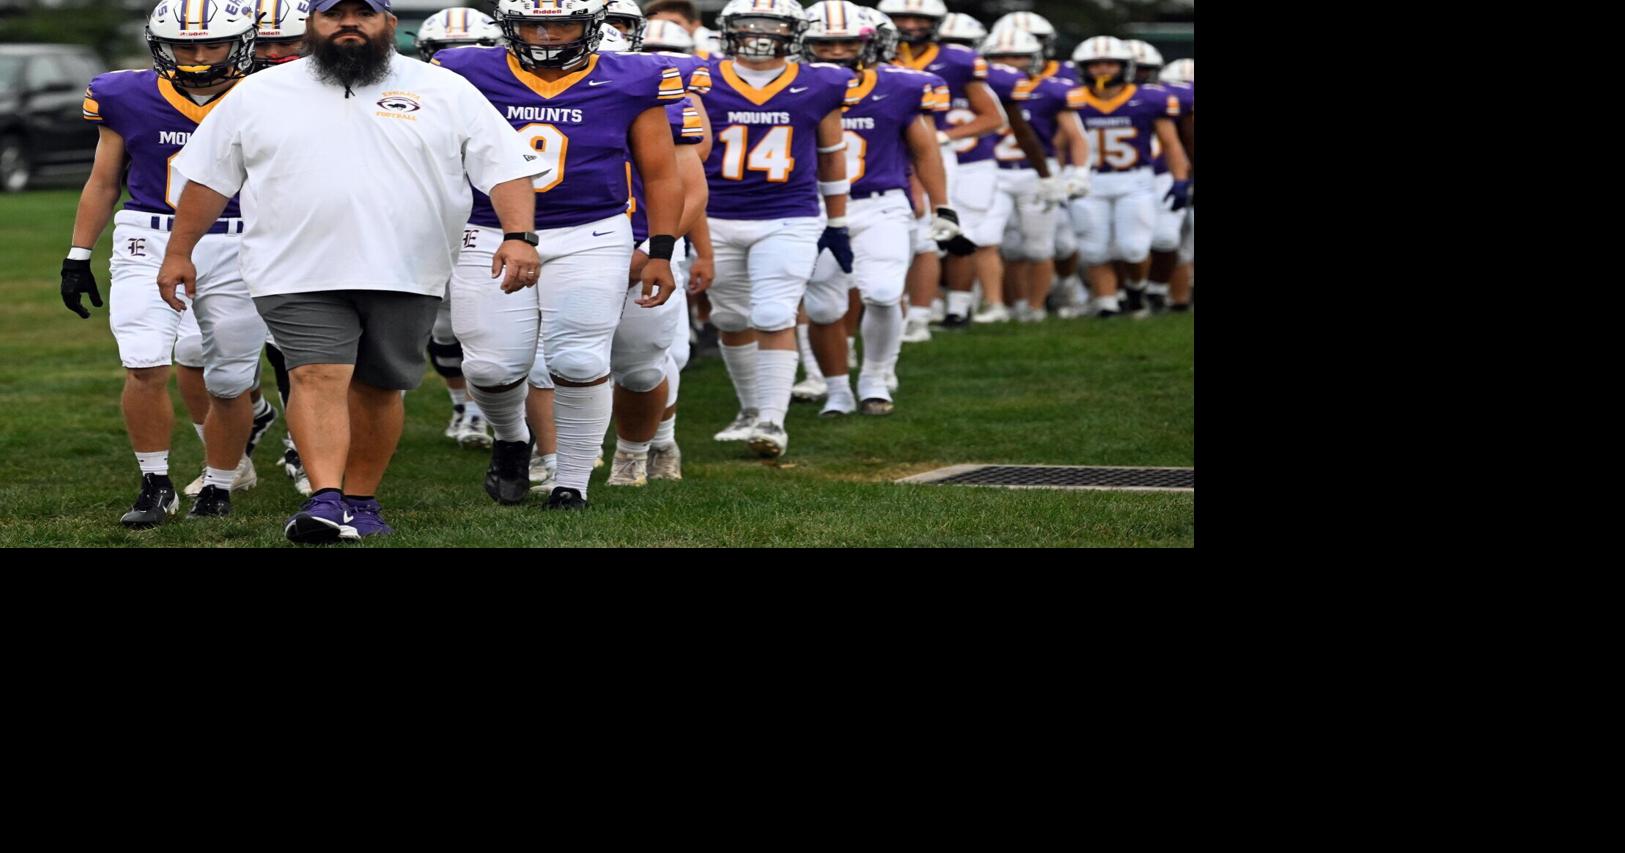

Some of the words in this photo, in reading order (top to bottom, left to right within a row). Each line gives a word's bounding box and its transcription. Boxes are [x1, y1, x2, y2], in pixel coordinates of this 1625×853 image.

[507, 105, 582, 123] MOUNTS
[728, 111, 790, 124] MOUNTS
[517, 123, 569, 193] 9
[719, 125, 795, 183] 14
